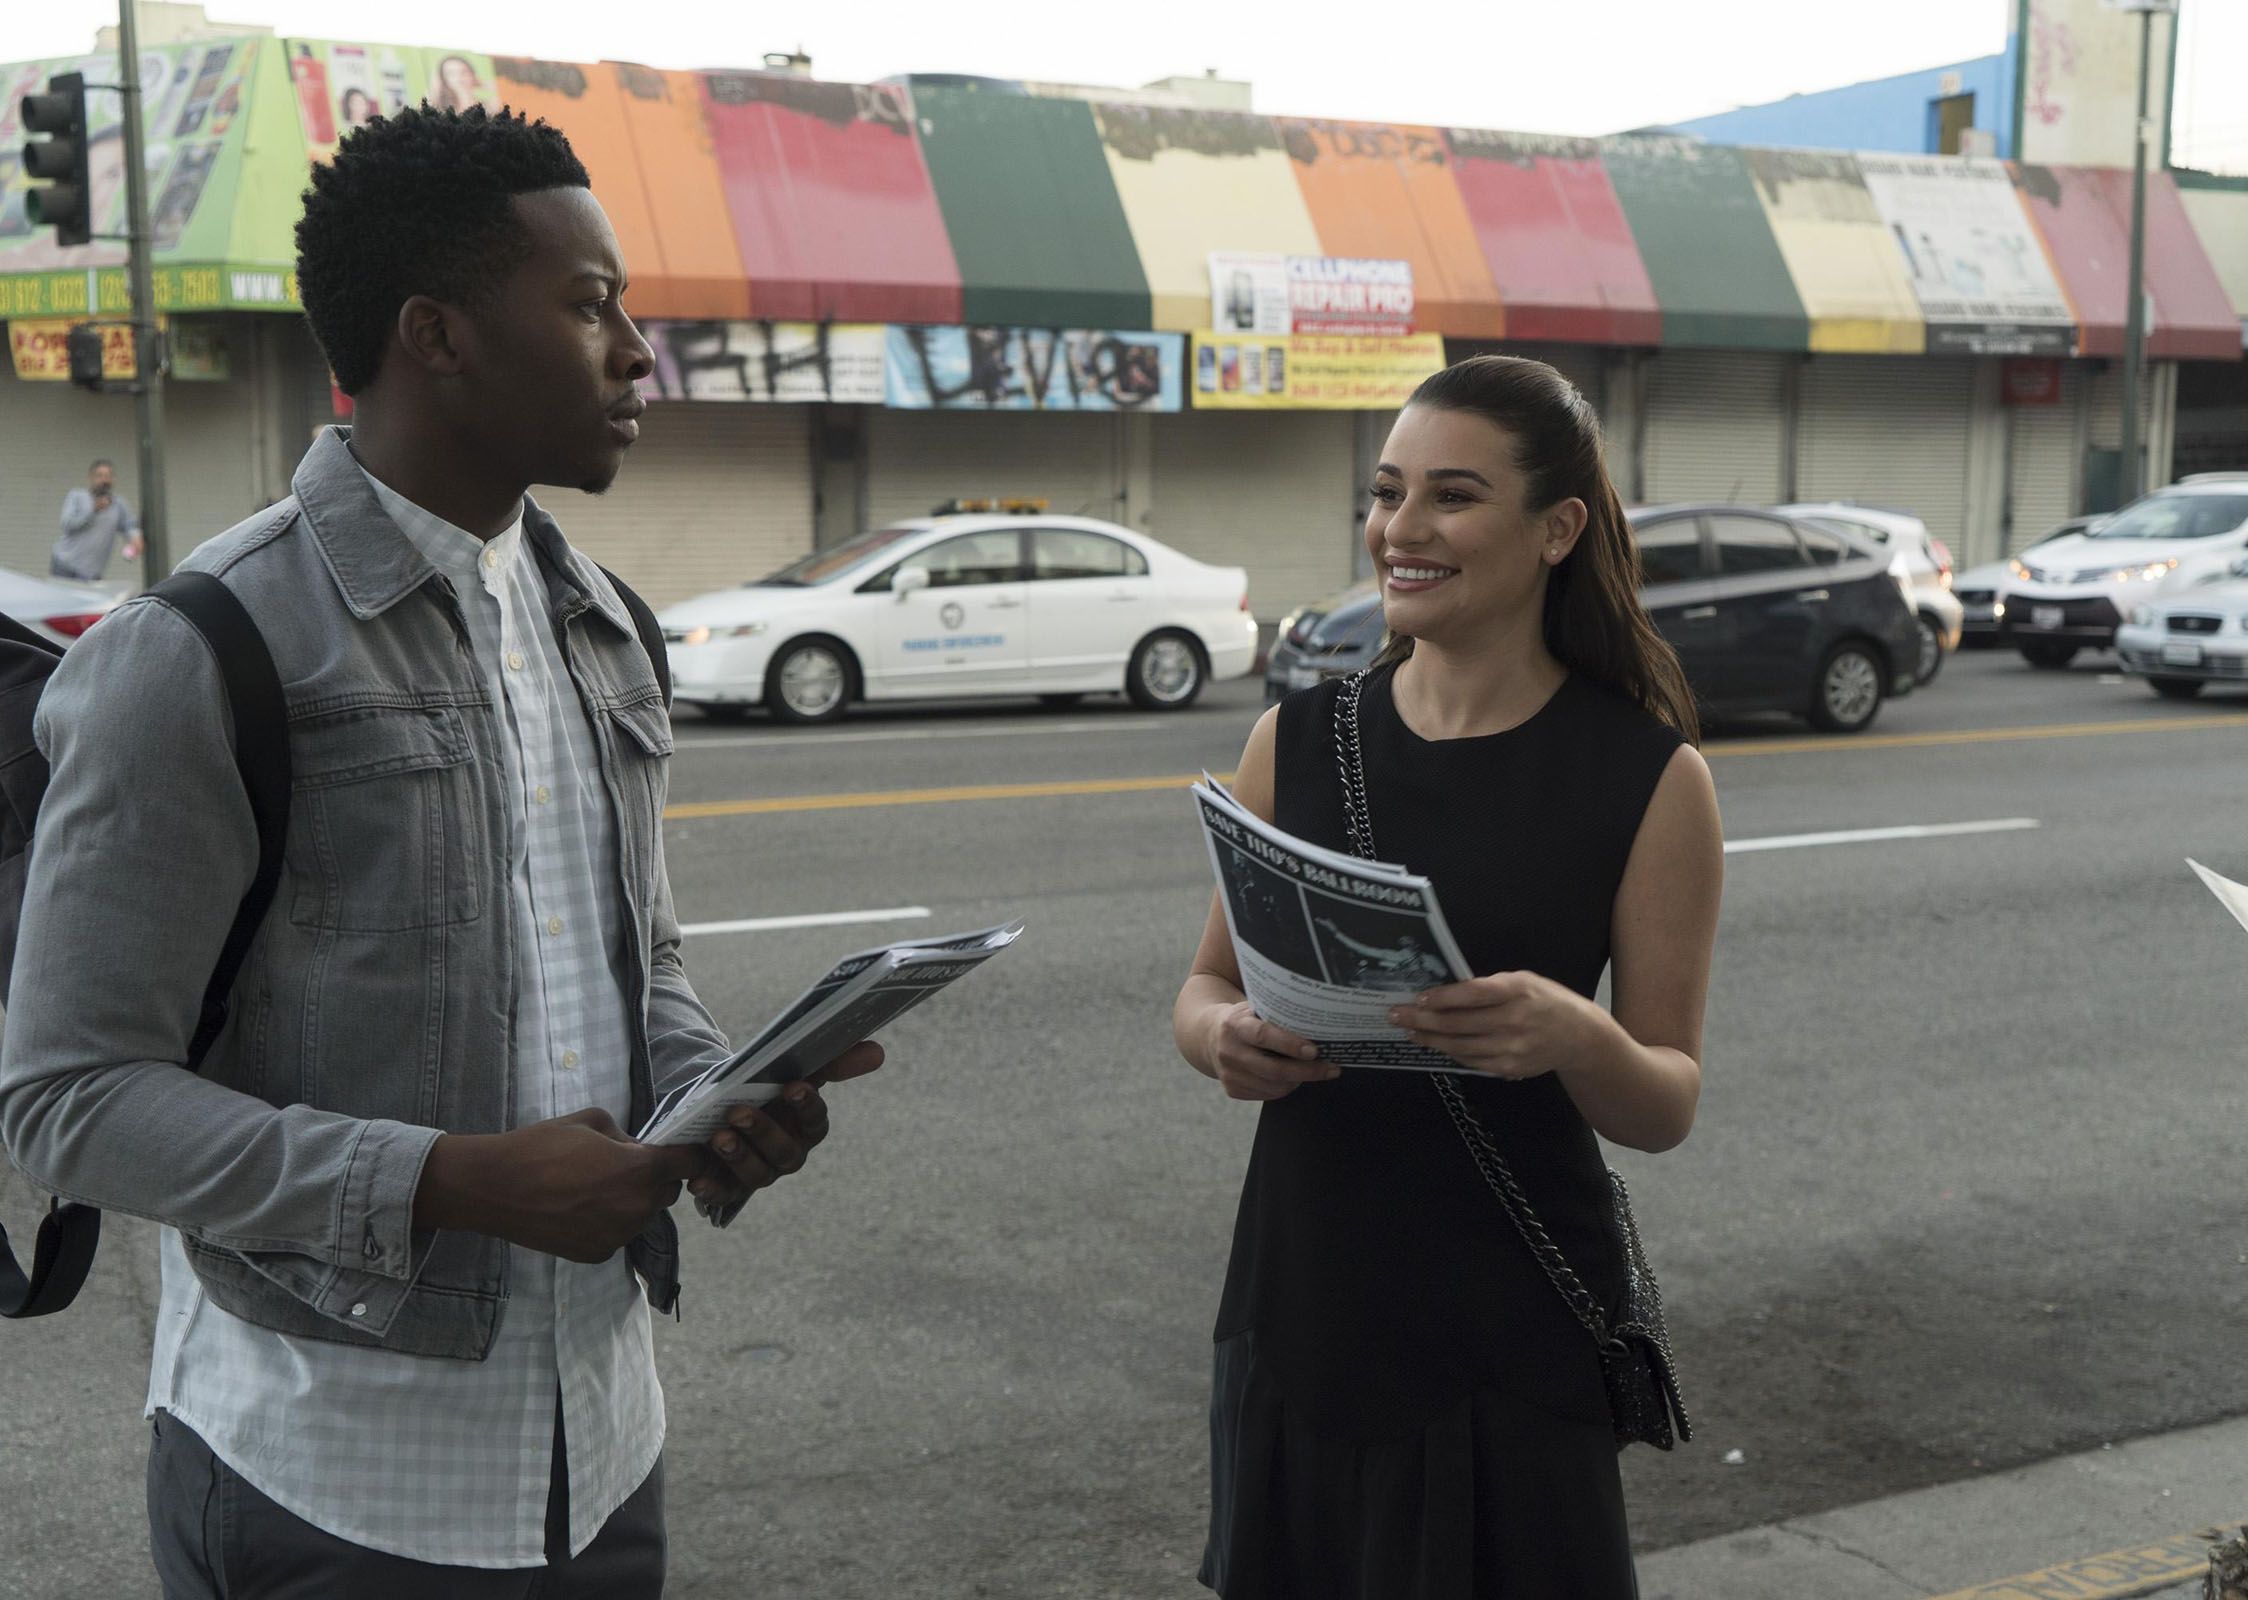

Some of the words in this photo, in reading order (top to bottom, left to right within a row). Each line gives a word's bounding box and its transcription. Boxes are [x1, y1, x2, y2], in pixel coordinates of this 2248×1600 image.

[1291, 283, 1365, 312] REPAIR
[1367, 285, 1414, 315] PRO
[1203, 806, 1243, 843] SAVE
[1245, 831, 1300, 874] TITO'S
[1302, 862, 1422, 907] BALLROOM
